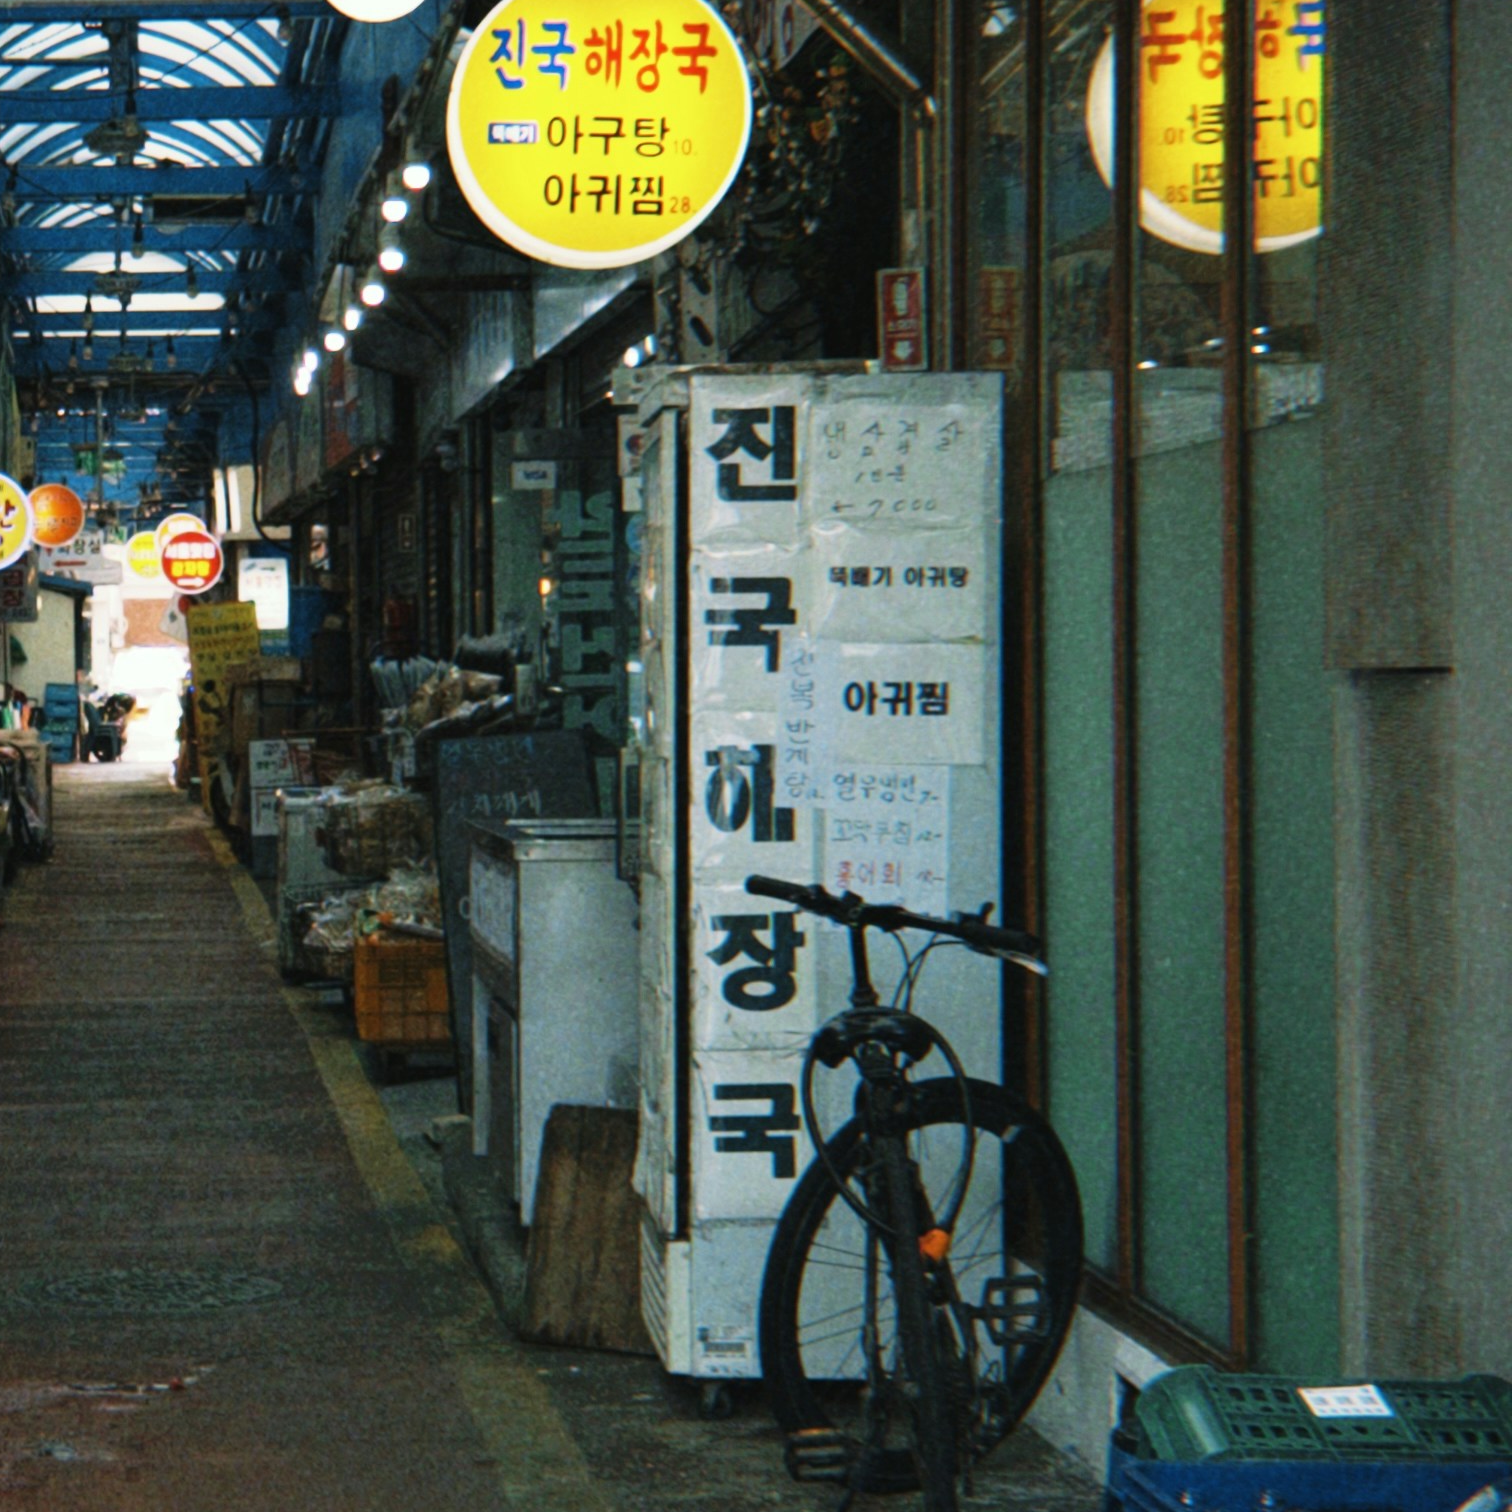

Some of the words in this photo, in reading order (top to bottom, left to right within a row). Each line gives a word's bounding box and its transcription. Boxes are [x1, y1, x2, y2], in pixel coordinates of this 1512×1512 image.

[489, 18, 577, 91] 진국
[583, 18, 718, 96] 해장국
[546, 114, 671, 157] 아구탕
[543, 173, 665, 216] 아귀찜
[828, 565, 893, 588] 뚝배기
[903, 566, 970, 588] 아귀탕
[842, 680, 951, 717] 아귀찜
